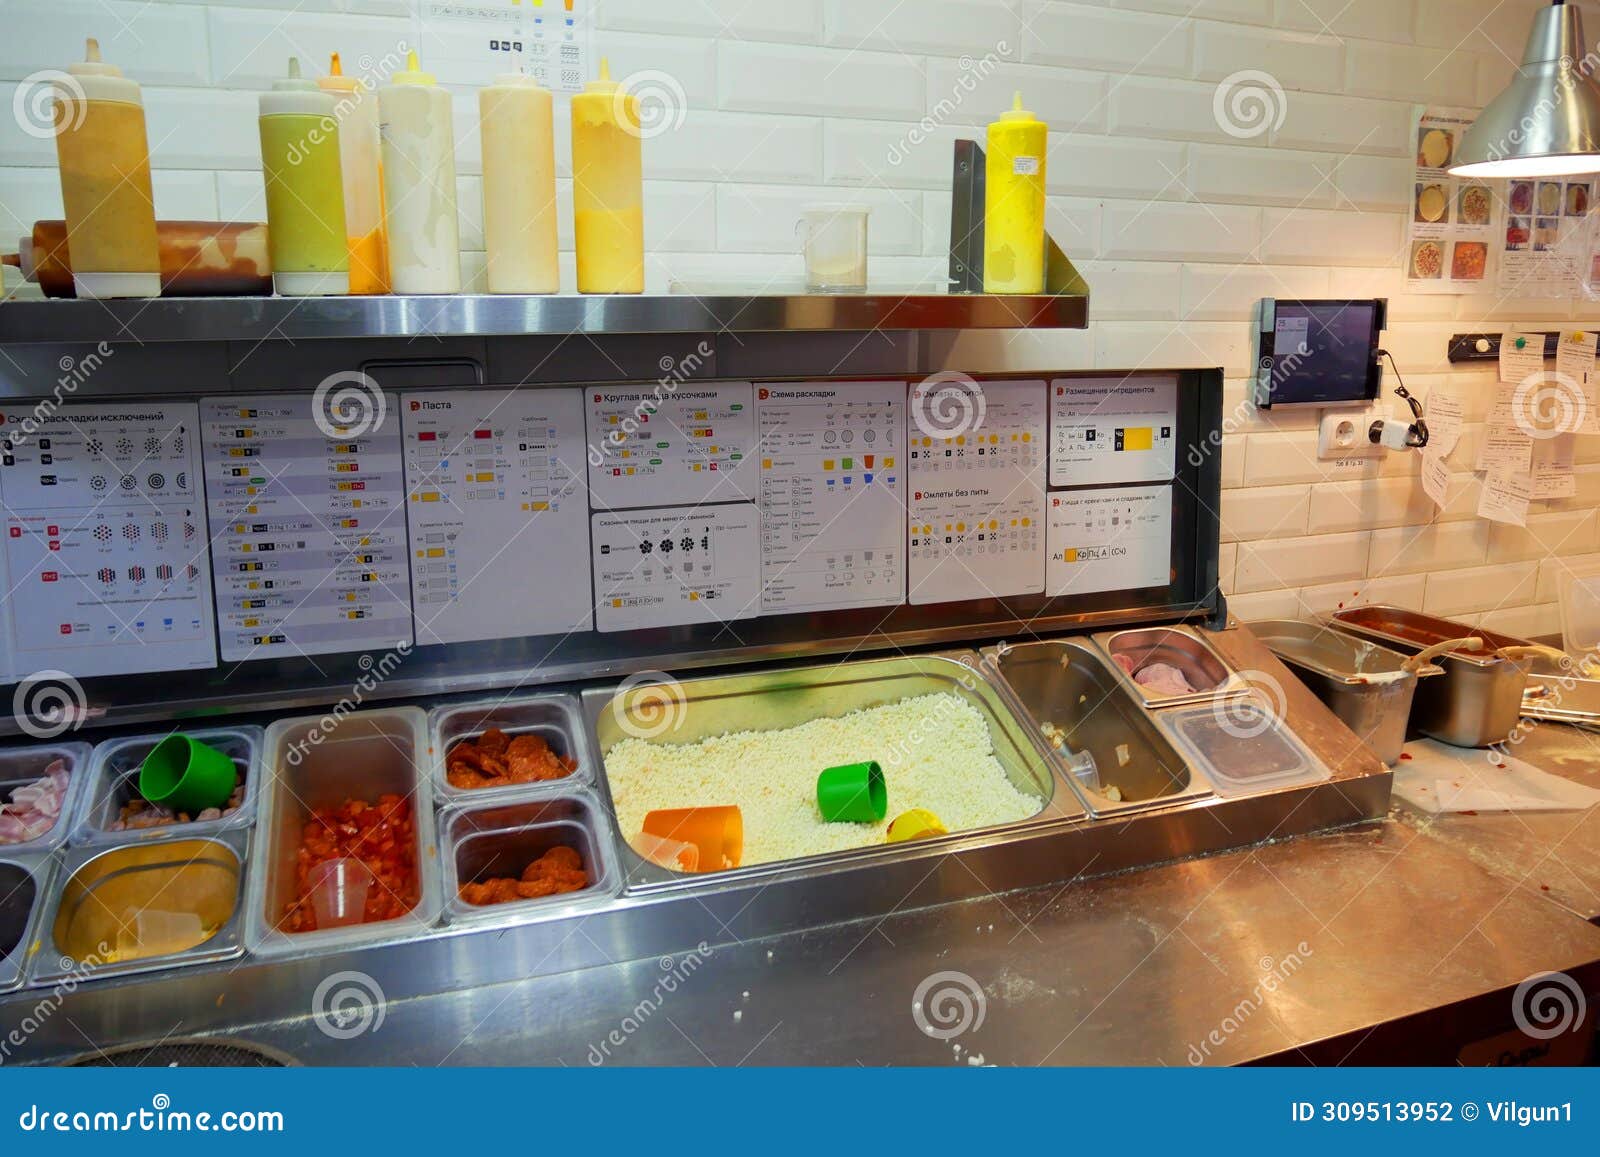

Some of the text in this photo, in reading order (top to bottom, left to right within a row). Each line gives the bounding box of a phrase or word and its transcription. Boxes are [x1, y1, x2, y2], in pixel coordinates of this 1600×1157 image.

[603, 392, 640, 404] Круглая
[671, 390, 718, 402] кусочками
[770, 390, 836, 400] Схема раскладки
[422, 400, 452, 411] Паста
[7, 411, 165, 425] Сха раскладки исключений
[923, 488, 989, 501] Омлеты без питы
[1052, 553, 1063, 562] Ал
